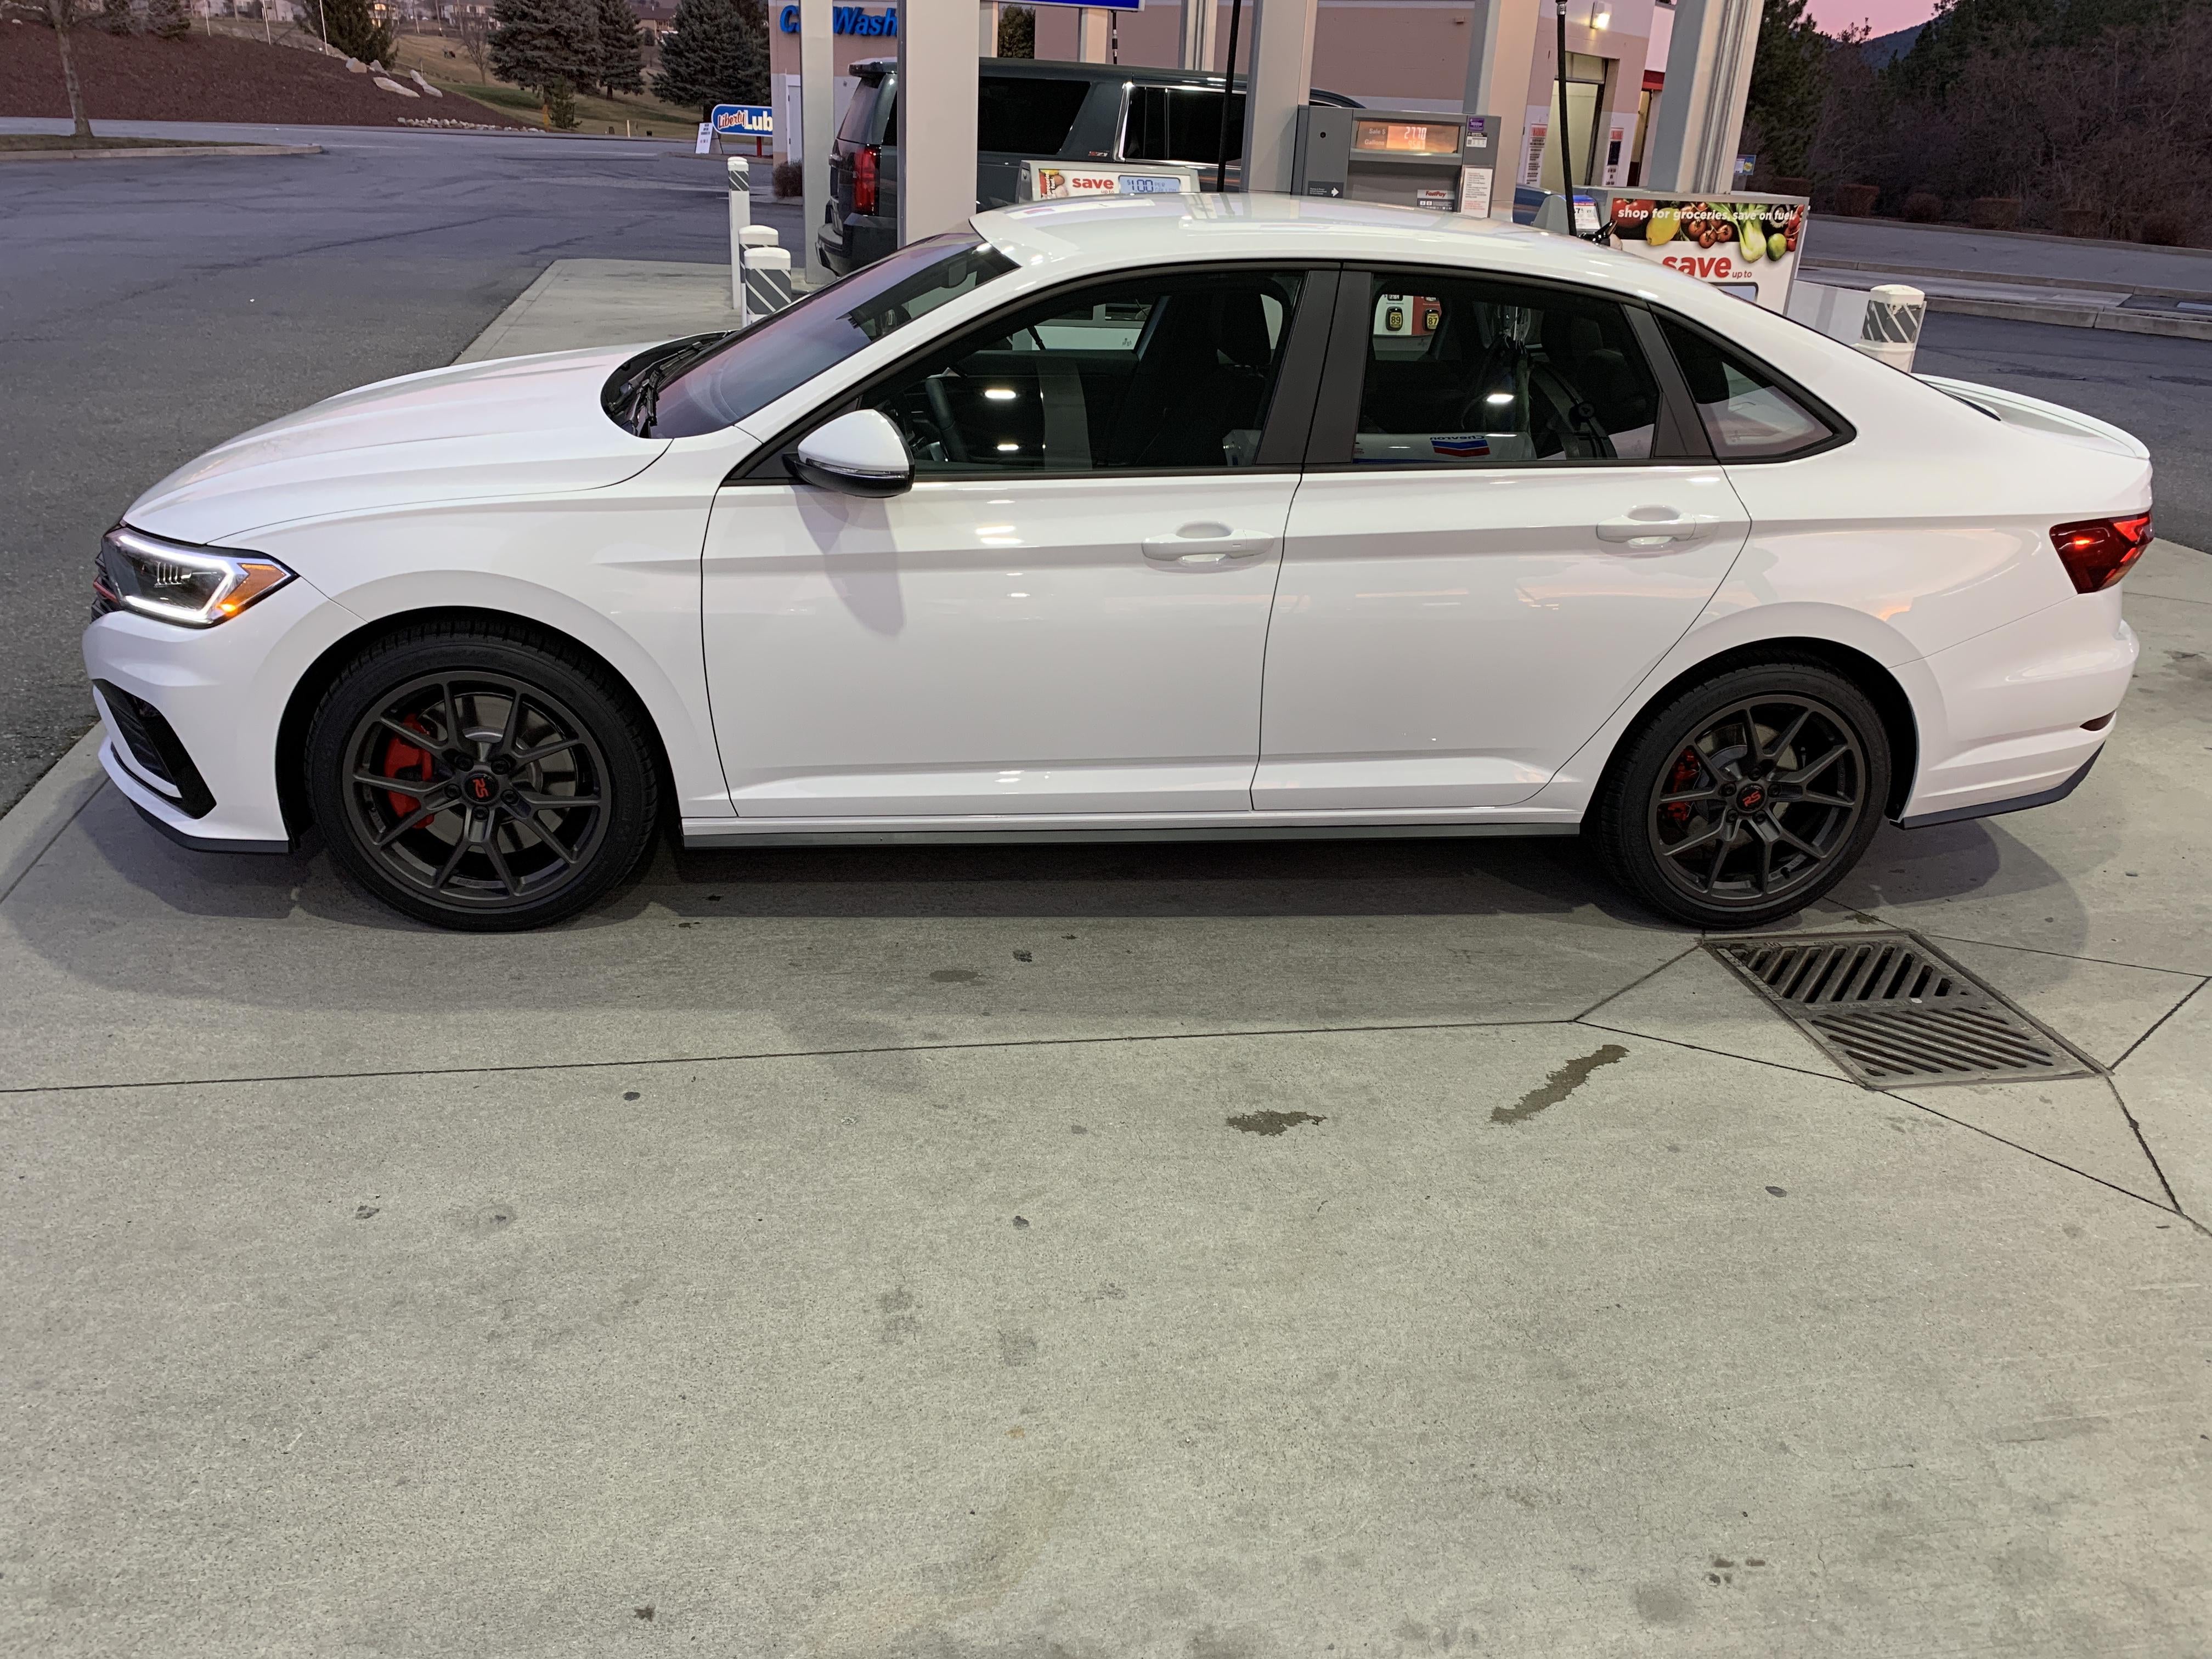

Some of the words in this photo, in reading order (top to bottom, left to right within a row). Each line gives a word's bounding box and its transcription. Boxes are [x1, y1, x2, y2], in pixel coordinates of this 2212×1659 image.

[833, 7, 897, 36] Wash
[718, 110, 746, 129] Liberty
[745, 110, 773, 132] Lub
[1072, 177, 1114, 189] save
[1618, 208, 1647, 220] shop
[1652, 208, 1670, 219] for
[1733, 211, 1756, 220] save
[1759, 212, 1773, 220] on
[1774, 210, 1796, 221] fuel.
[1662, 256, 1731, 278] save
